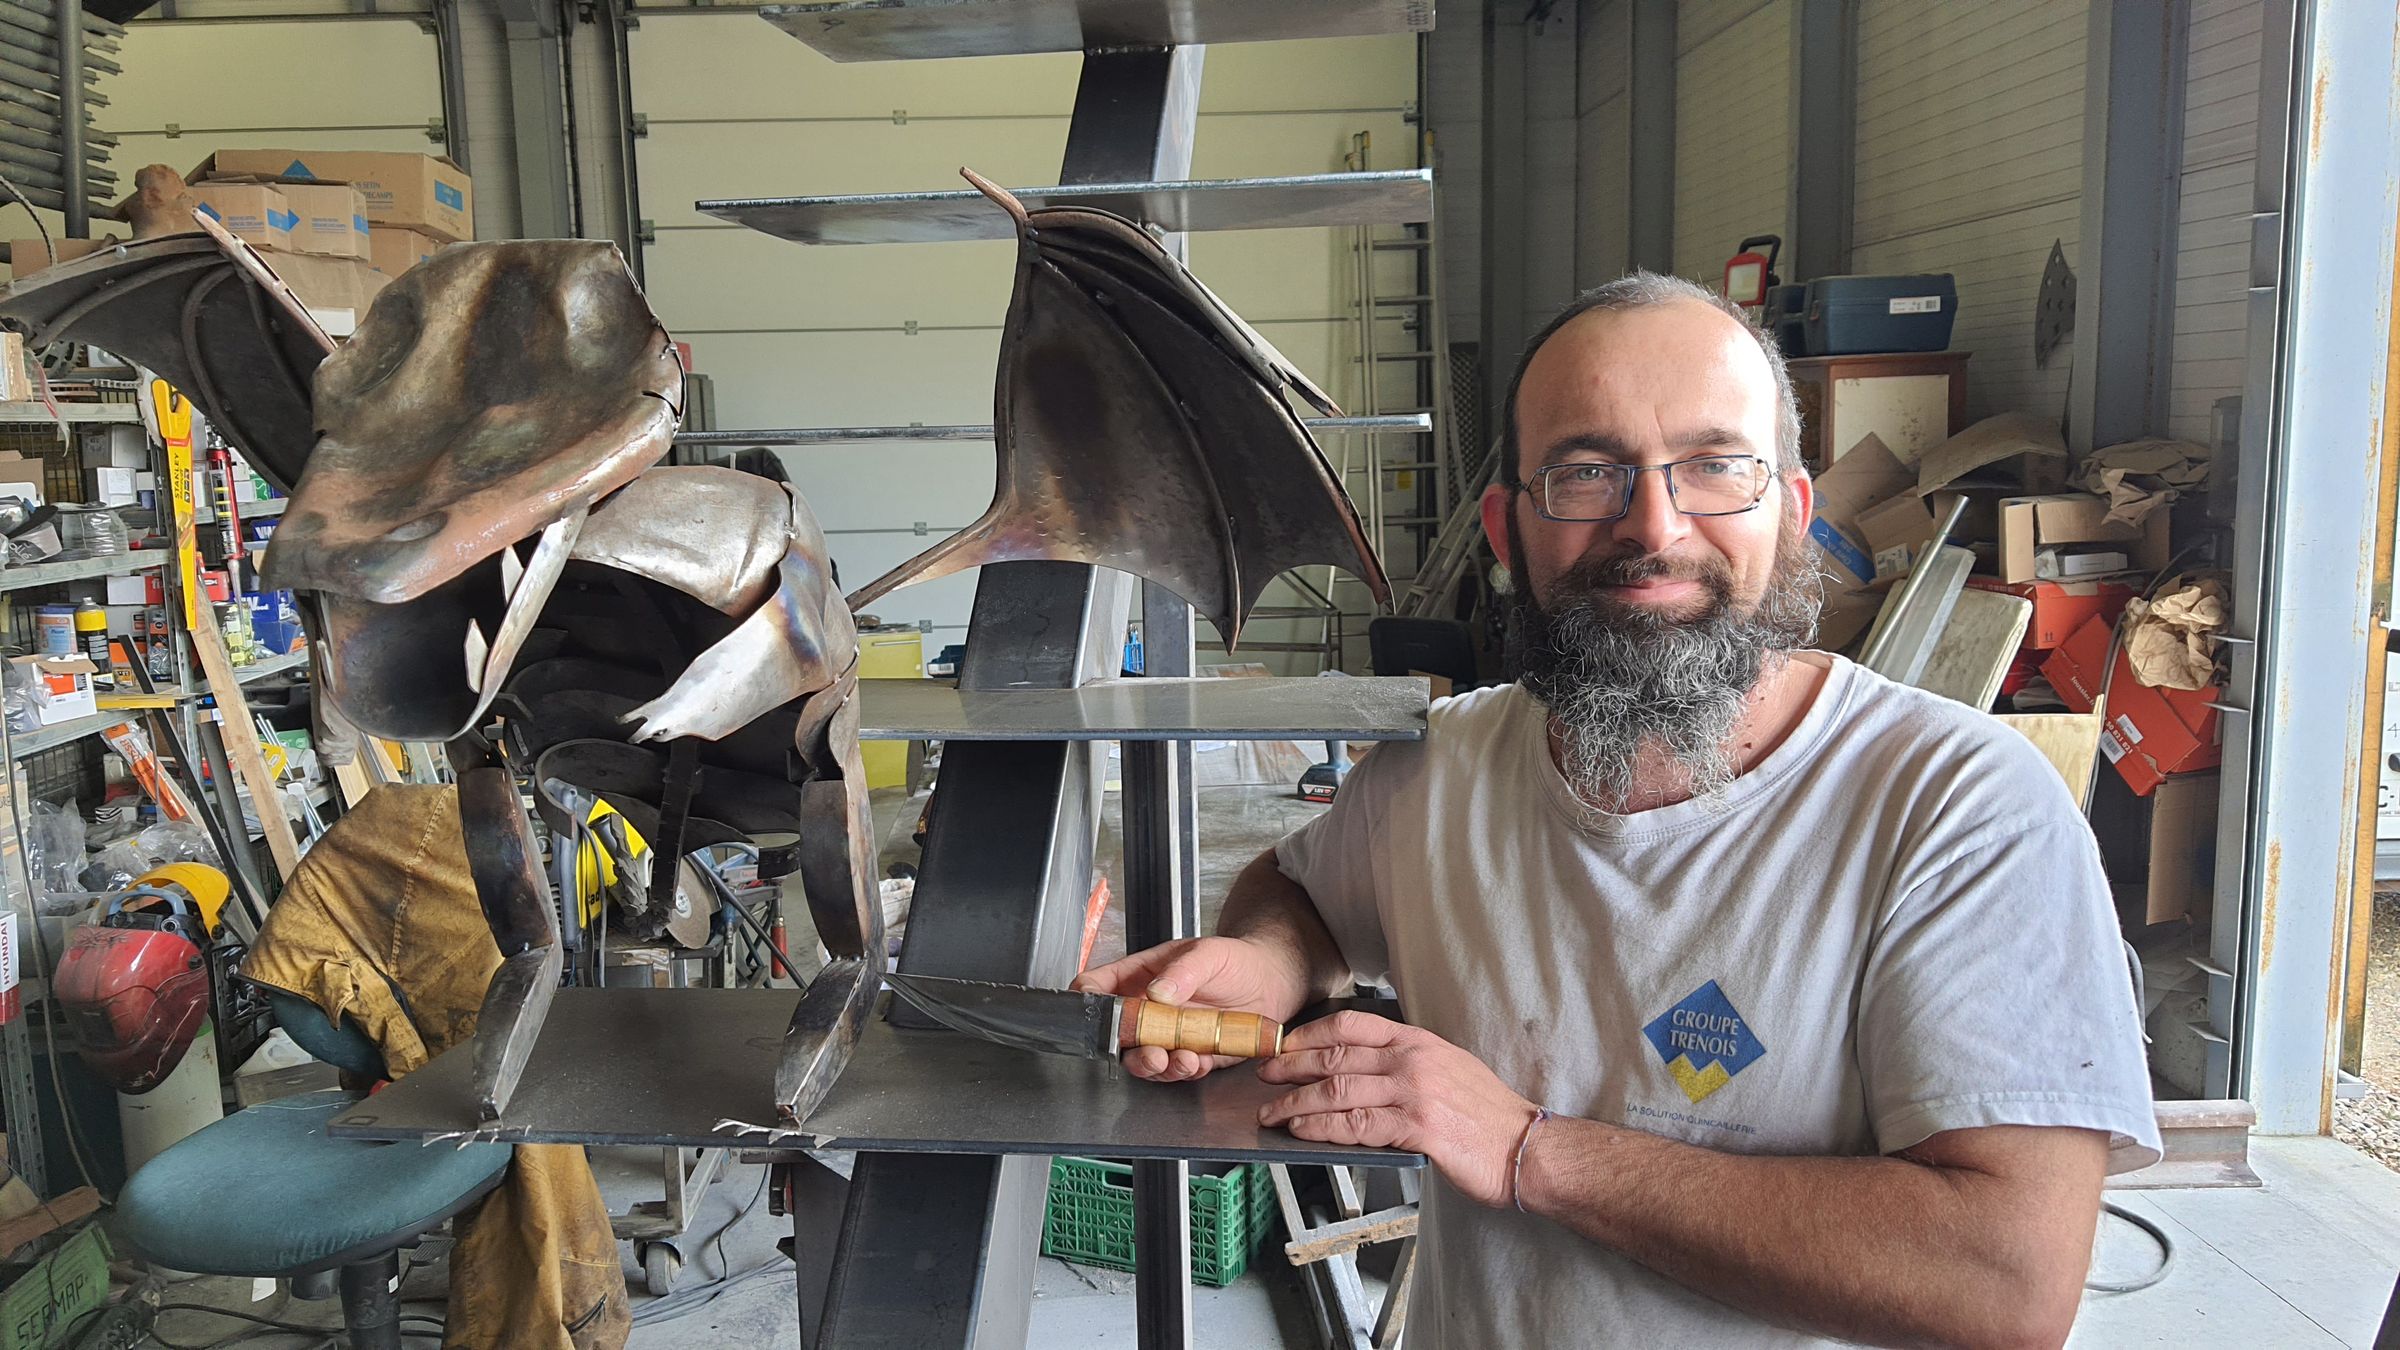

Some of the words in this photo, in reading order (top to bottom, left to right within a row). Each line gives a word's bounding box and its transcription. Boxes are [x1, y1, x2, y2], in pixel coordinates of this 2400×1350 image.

[1, 921, 10, 985] HYUNDAI
[1672, 1008, 1740, 1036] GROUPE
[1669, 1029, 1737, 1057] TRENOIS
[1626, 1103, 1638, 1112] LA
[1639, 1106, 1685, 1122] SOLUTION
[1686, 1114, 1757, 1136] QUINCAILLERIE
